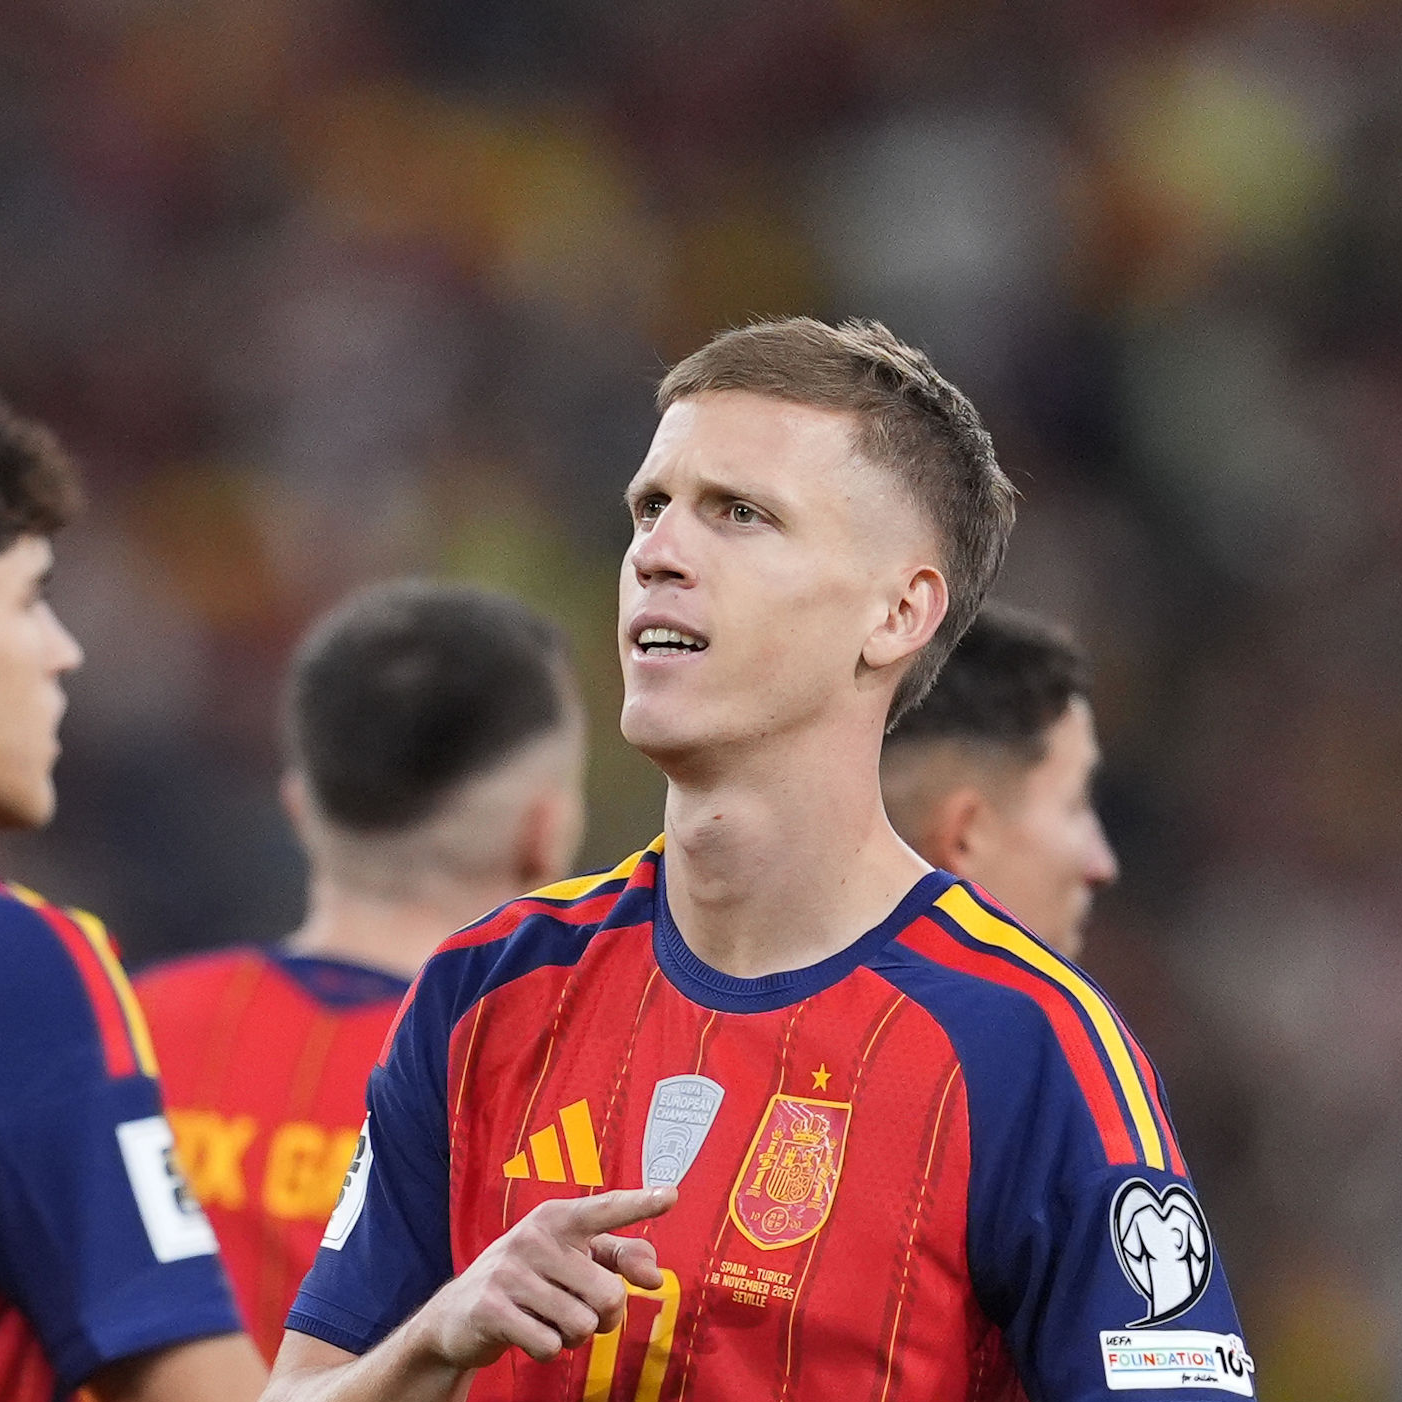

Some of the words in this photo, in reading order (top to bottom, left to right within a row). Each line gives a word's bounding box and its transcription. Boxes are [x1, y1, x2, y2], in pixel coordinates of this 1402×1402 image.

[659, 1094, 715, 1112] EUROPEAN
[655, 1108, 709, 1126] CHAMPIONS
[649, 1167, 678, 1182] 2024
[720, 1261, 748, 1277] SPAIN
[757, 1268, 793, 1286] TURKEY
[722, 1275, 770, 1296] NOVEMBER
[771, 1285, 795, 1301] 2025
[732, 1290, 768, 1308] SEVILLE
[1106, 1336, 1132, 1346] UEFA
[1108, 1352, 1215, 1367] FOUNDATION
[1182, 1373, 1191, 1384] for
